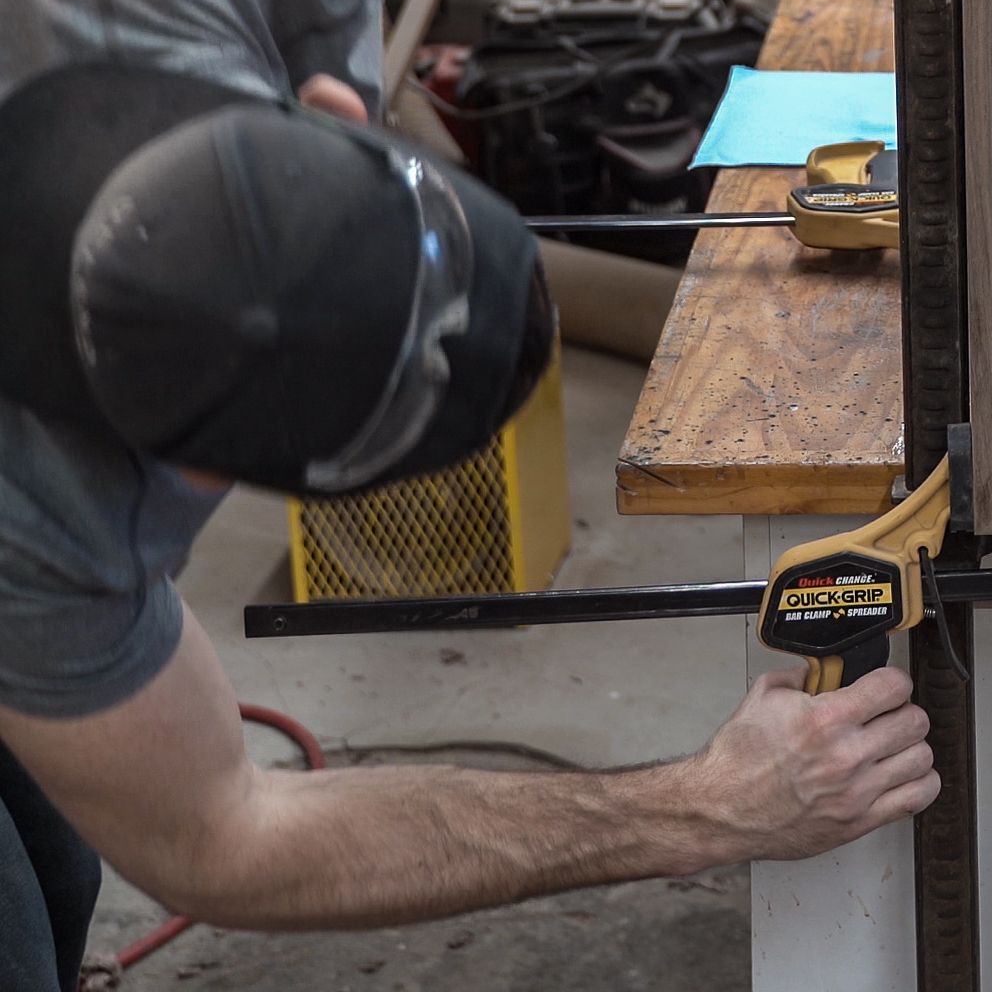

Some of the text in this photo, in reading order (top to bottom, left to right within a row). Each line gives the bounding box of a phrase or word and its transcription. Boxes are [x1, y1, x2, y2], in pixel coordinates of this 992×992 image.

[798, 574, 873, 587] Quick CHANGE
[785, 607, 887, 621] BAR CLAMP SPREADER
